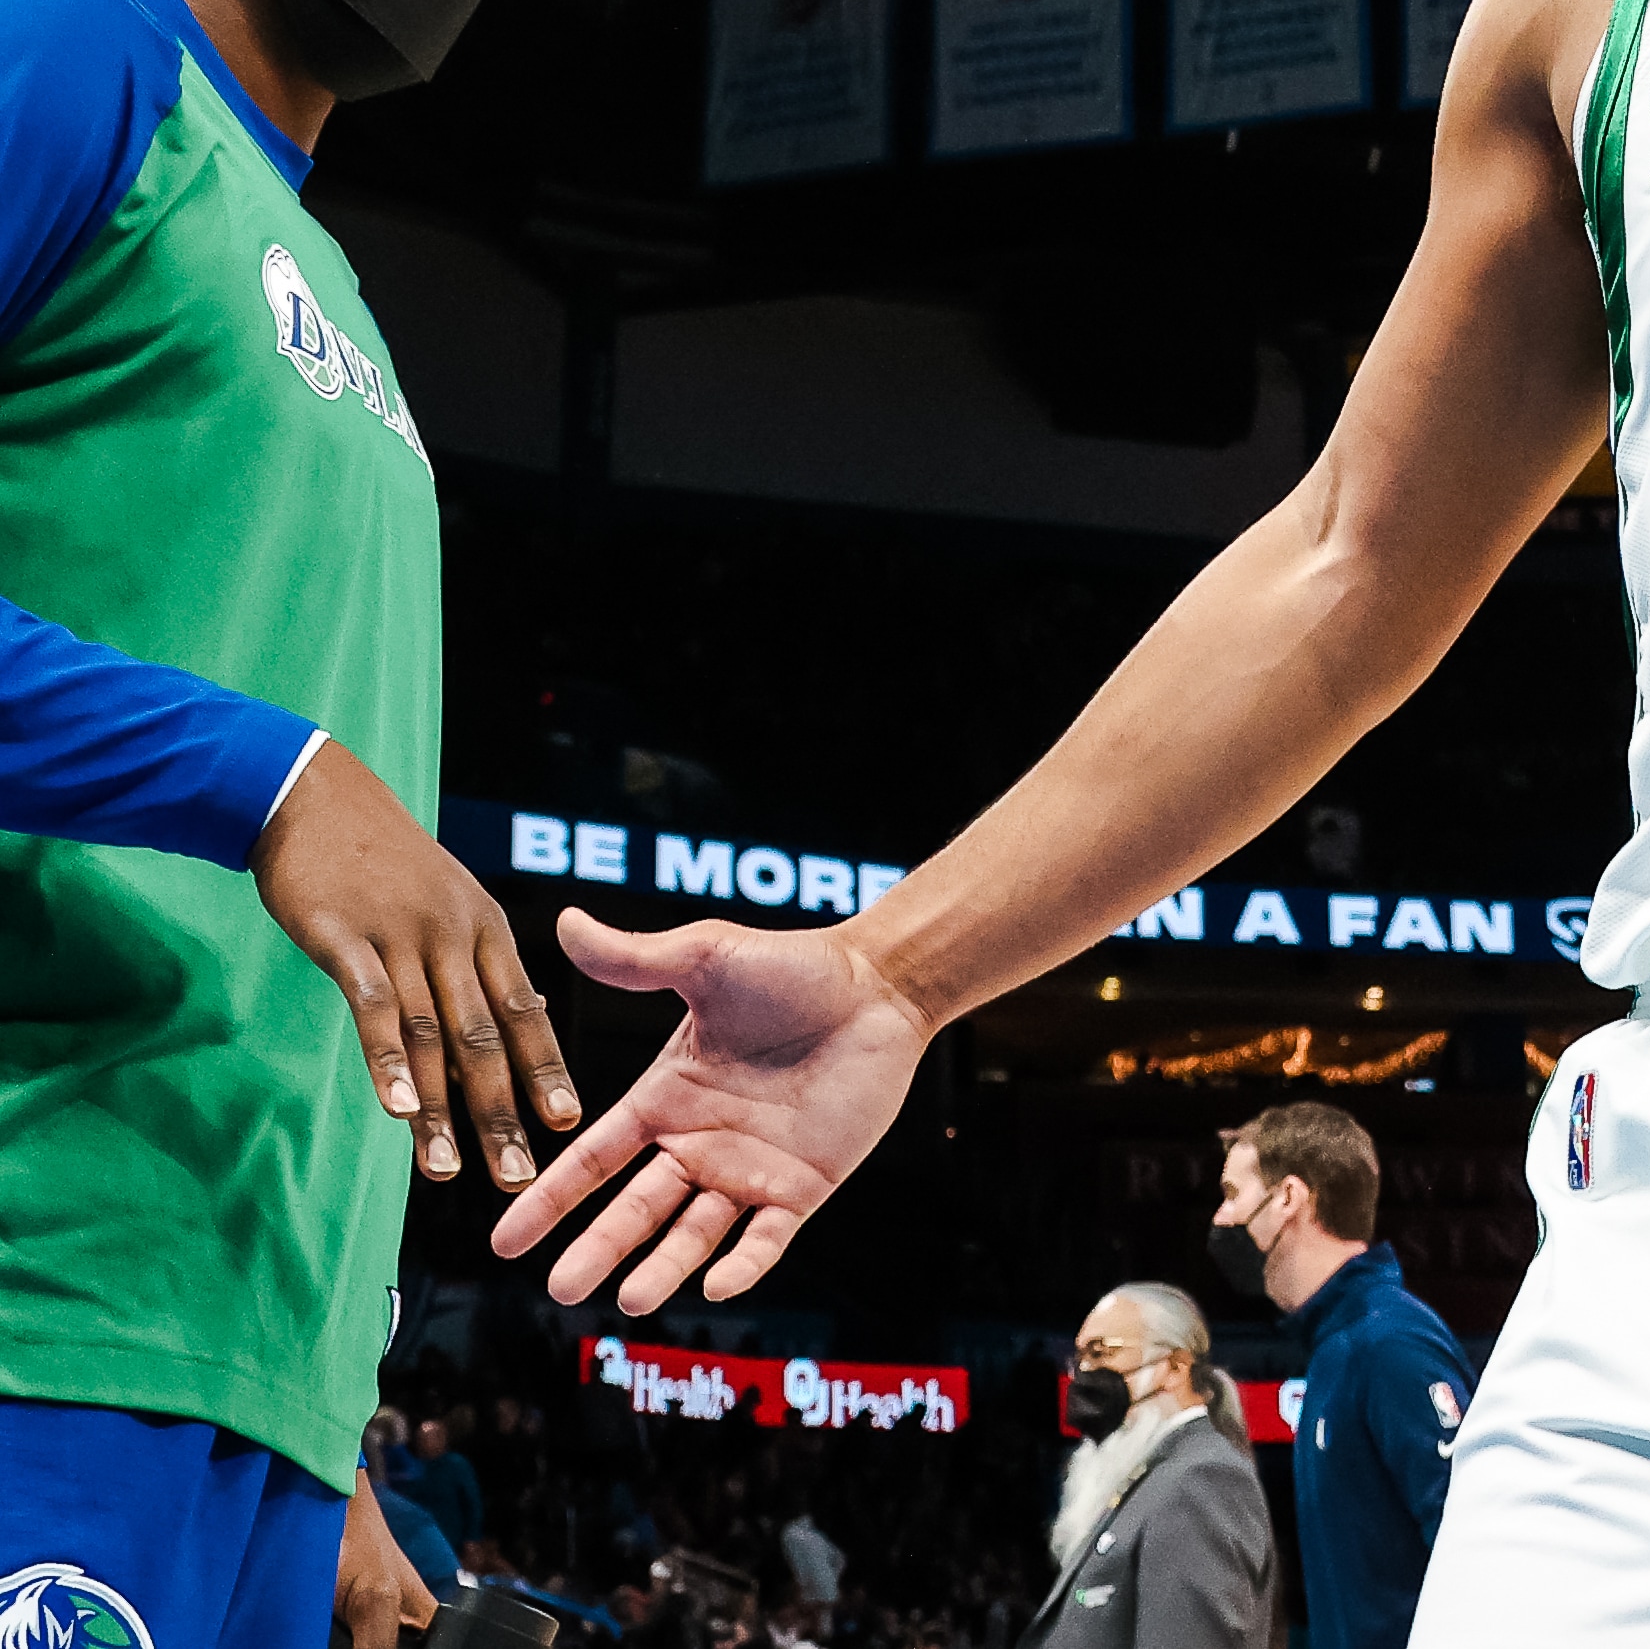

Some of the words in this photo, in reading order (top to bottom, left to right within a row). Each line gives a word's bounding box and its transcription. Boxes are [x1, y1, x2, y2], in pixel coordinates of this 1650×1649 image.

[510, 811, 628, 885] BE
[1234, 891, 1300, 944] A
[1329, 893, 1513, 954] FAN
